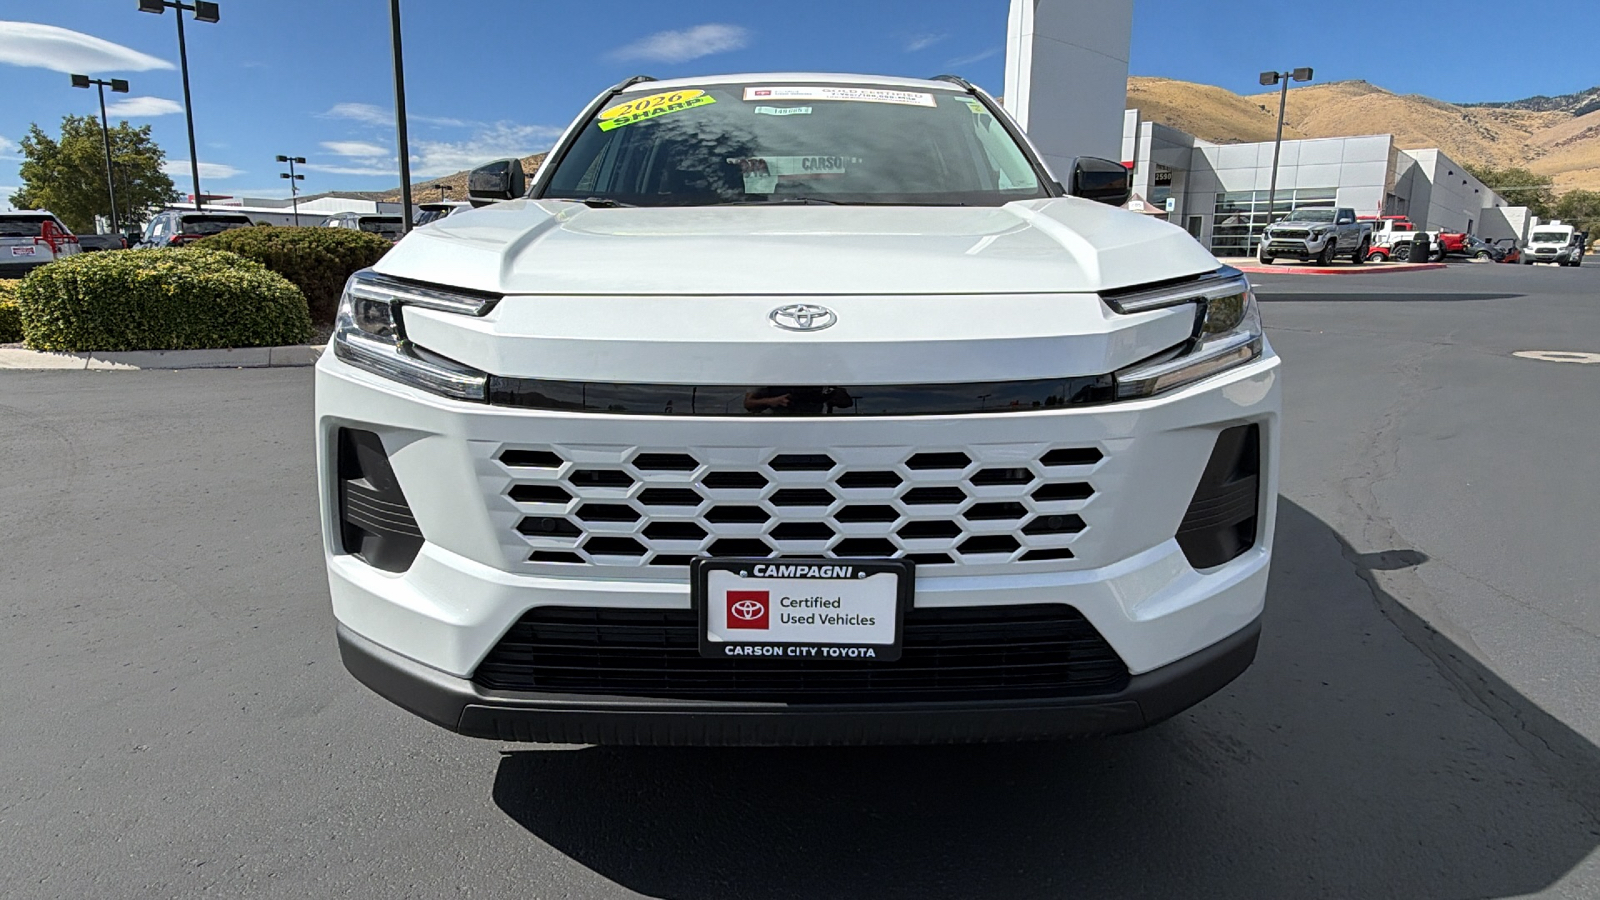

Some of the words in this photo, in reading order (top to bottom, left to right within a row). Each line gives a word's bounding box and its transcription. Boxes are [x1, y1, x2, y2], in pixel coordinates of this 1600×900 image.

[618, 92, 683, 117] 2026
[613, 98, 704, 126] SHARP
[802, 156, 848, 171] CARSO
[753, 564, 853, 578] CAMPAGNI
[780, 596, 841, 609] Certified
[780, 612, 815, 625] Used
[818, 613, 876, 626] Vehicles
[724, 645, 783, 656] CARSON
[787, 646, 818, 657] CITY
[821, 647, 876, 658] TOYOTA
